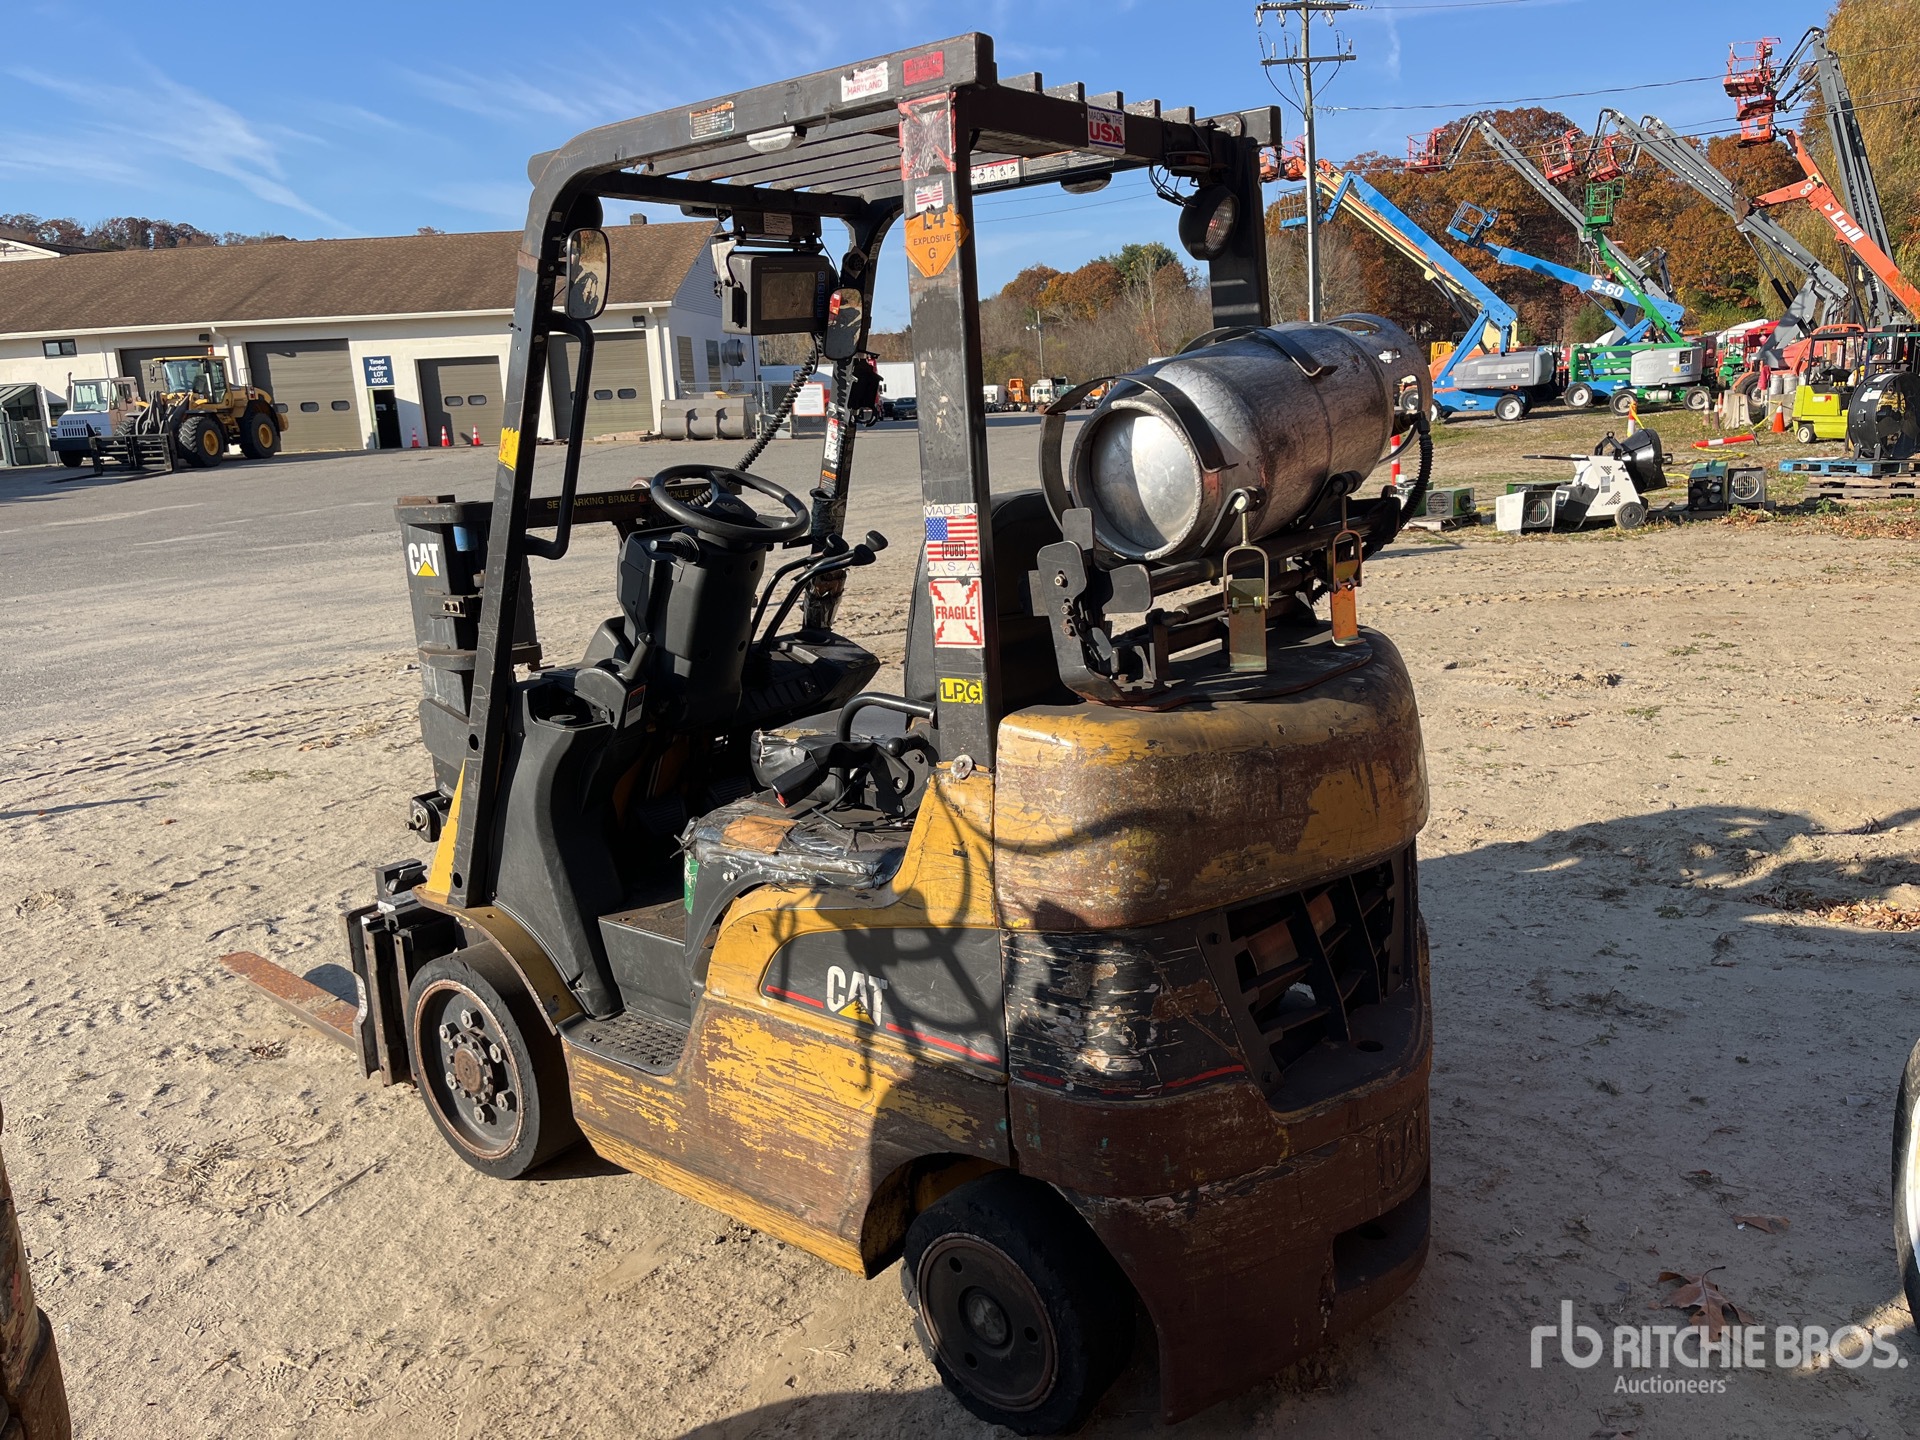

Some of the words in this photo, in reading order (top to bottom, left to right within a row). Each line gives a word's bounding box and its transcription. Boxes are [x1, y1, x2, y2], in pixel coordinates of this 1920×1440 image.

[847, 80, 882, 95] MARYLAND
[1088, 110, 1104, 121] MADE
[1111, 115, 1123, 126] THE
[1088, 121, 1124, 145] USA
[913, 233, 951, 246] EXPLOSIVE
[928, 247, 937, 259] G
[1592, 279, 1625, 298] S-60
[546, 500, 562, 509] SE
[572, 496, 605, 507] ARKING
[608, 494, 635, 504] BRAKE
[924, 505, 960, 516] MADE
[964, 504, 977, 514] IN
[944, 543, 964, 557] PUBG
[407, 542, 440, 577] CAT
[935, 605, 976, 620] FRAGILE
[941, 681, 982, 701] LPG
[826, 965, 889, 1027] CAT
